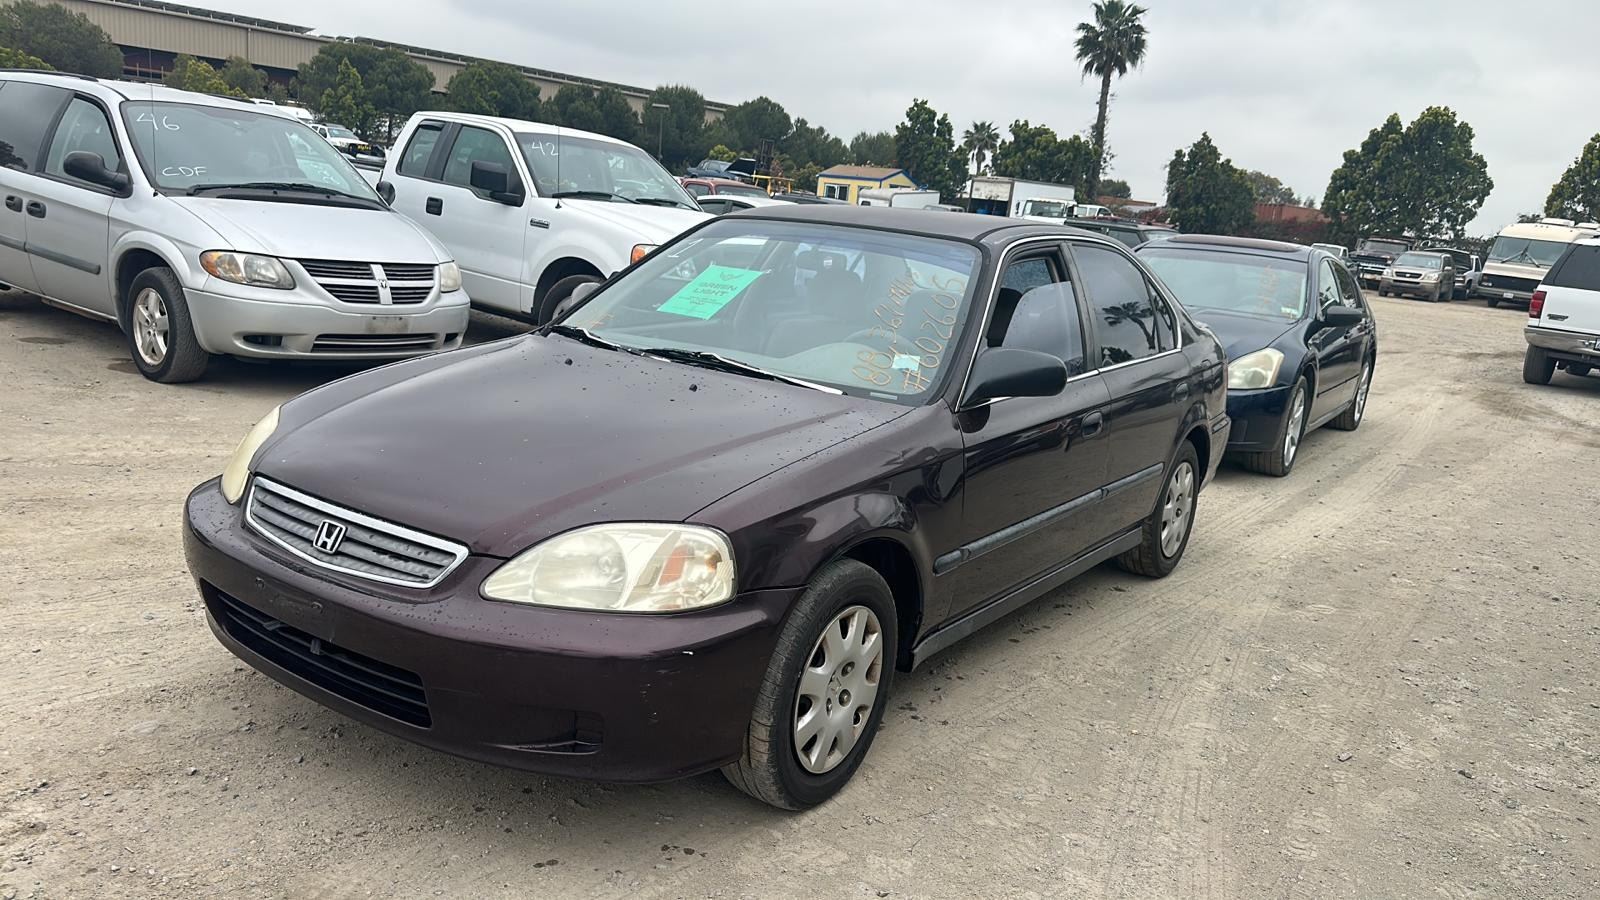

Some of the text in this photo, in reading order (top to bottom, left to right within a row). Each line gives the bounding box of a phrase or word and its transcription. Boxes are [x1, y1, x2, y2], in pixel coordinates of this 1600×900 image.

[136, 112, 181, 132] 46
[531, 141, 560, 156] 42
[161, 166, 207, 177] CDF
[693, 288, 729, 297] LIGHT
